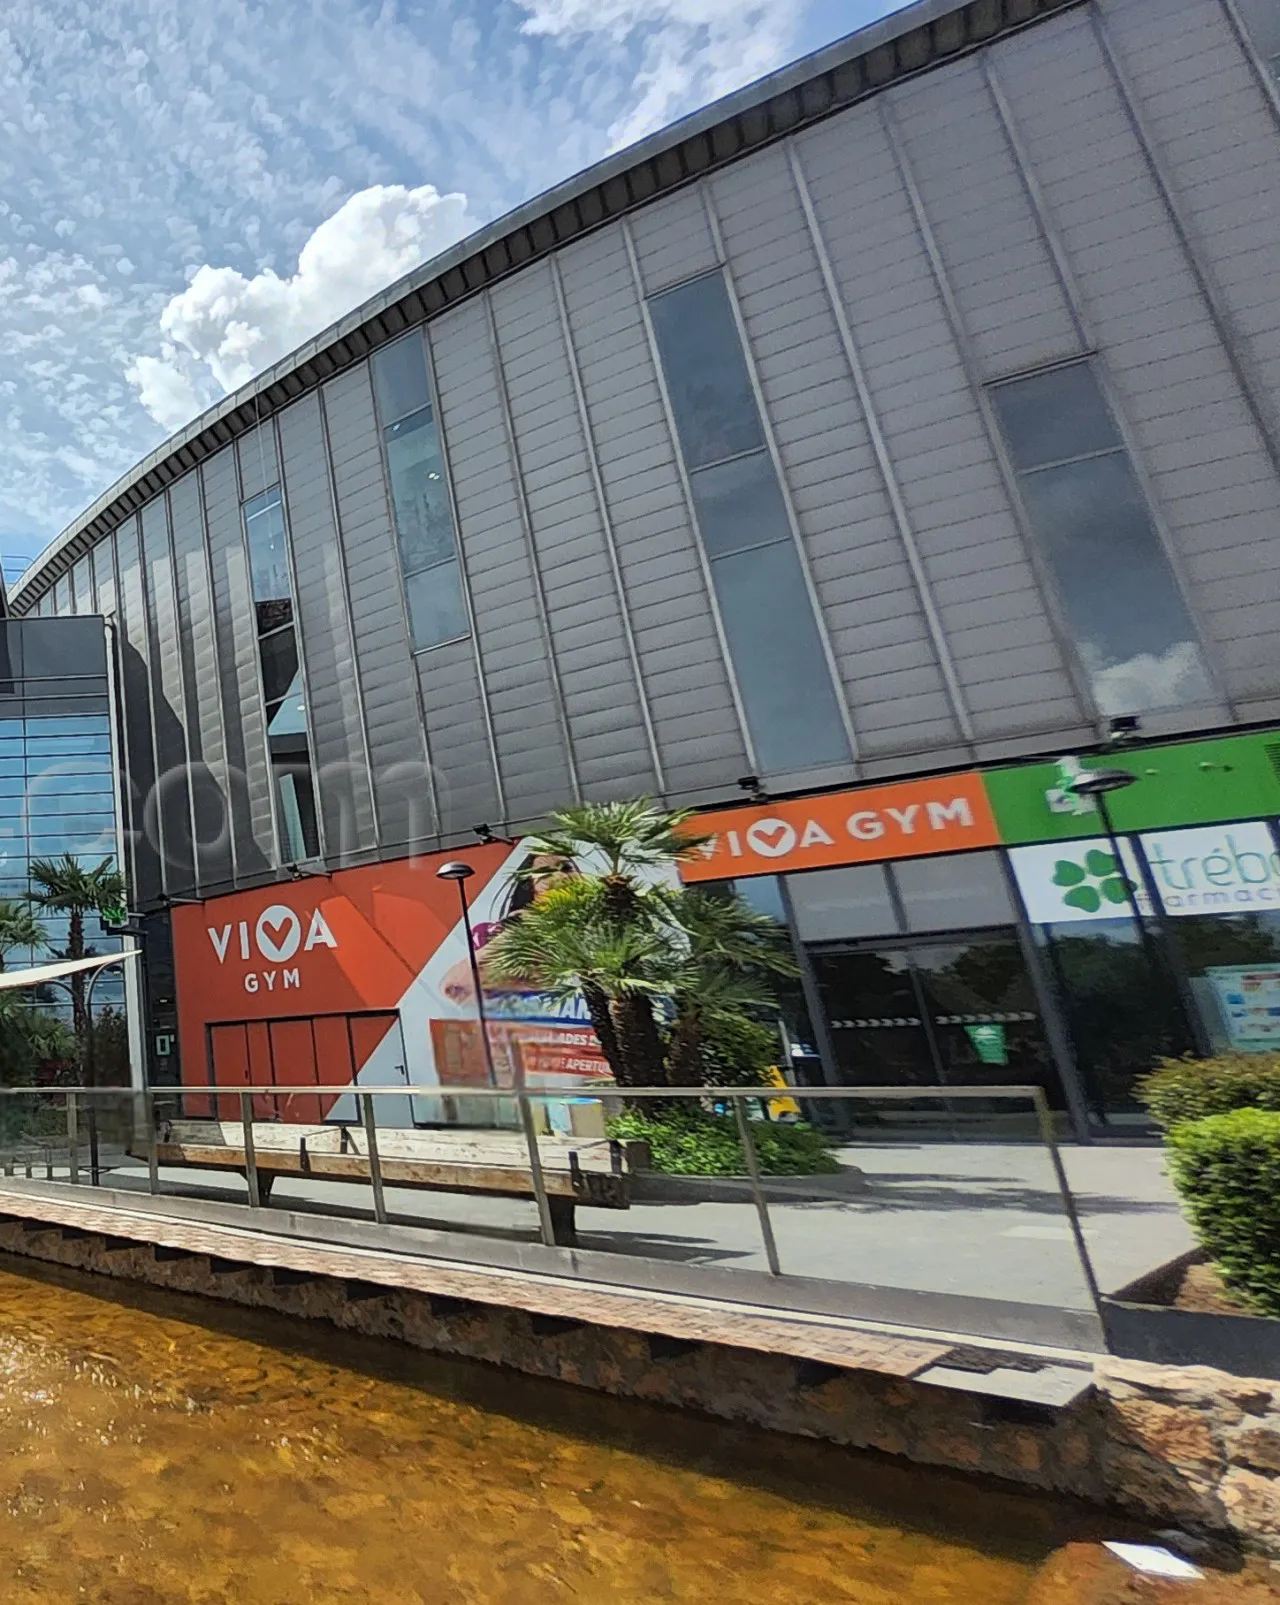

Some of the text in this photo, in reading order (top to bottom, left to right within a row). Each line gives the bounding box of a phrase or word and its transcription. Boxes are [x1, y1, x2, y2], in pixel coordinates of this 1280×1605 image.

[845, 797, 974, 841] GYM
[207, 904, 338, 964] VIVA
[245, 968, 301, 993] GYM
